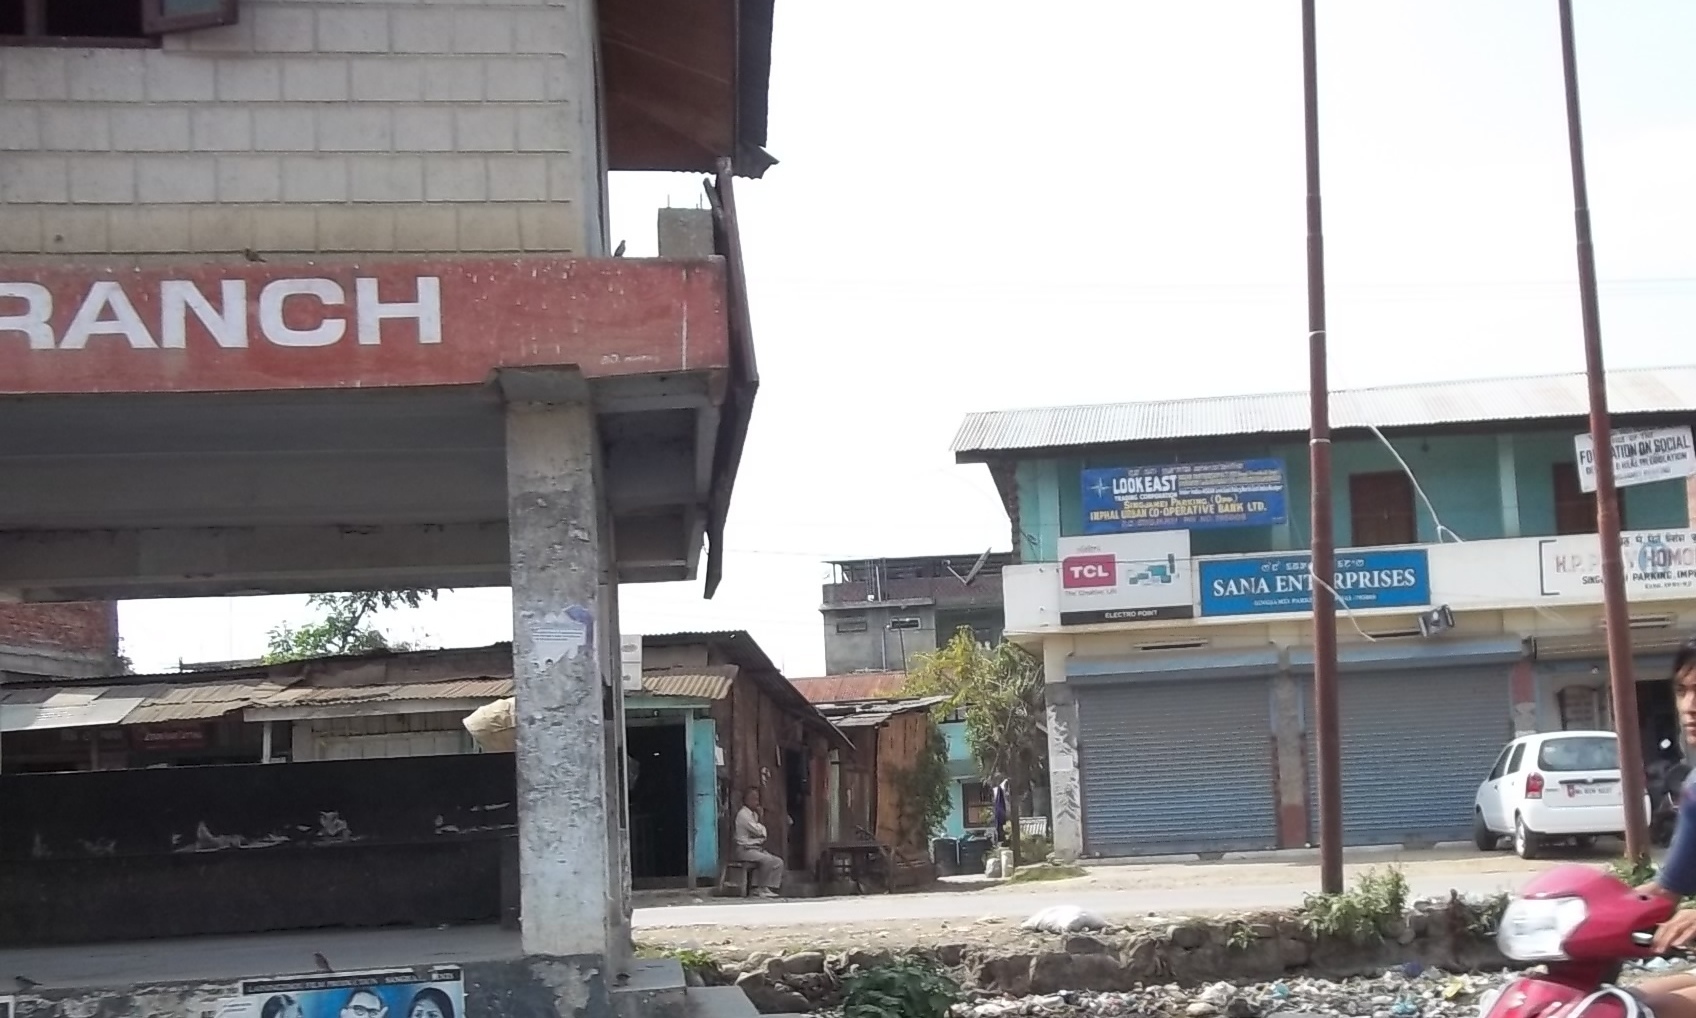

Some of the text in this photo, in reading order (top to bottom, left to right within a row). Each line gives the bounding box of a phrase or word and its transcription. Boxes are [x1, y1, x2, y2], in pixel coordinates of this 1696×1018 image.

[0, 276, 442, 349] RANCH
[1580, 442, 1638, 466] FOATION
[1654, 435, 1692, 453] SOCIAL
[1643, 547, 1696, 567] HOMO
[1070, 564, 1110, 579] TCL
[1632, 570, 1672, 581] PARKING
[1213, 568, 1416, 598] SANA ENTRPRISES
[1105, 610, 1137, 619] ELECTRO
